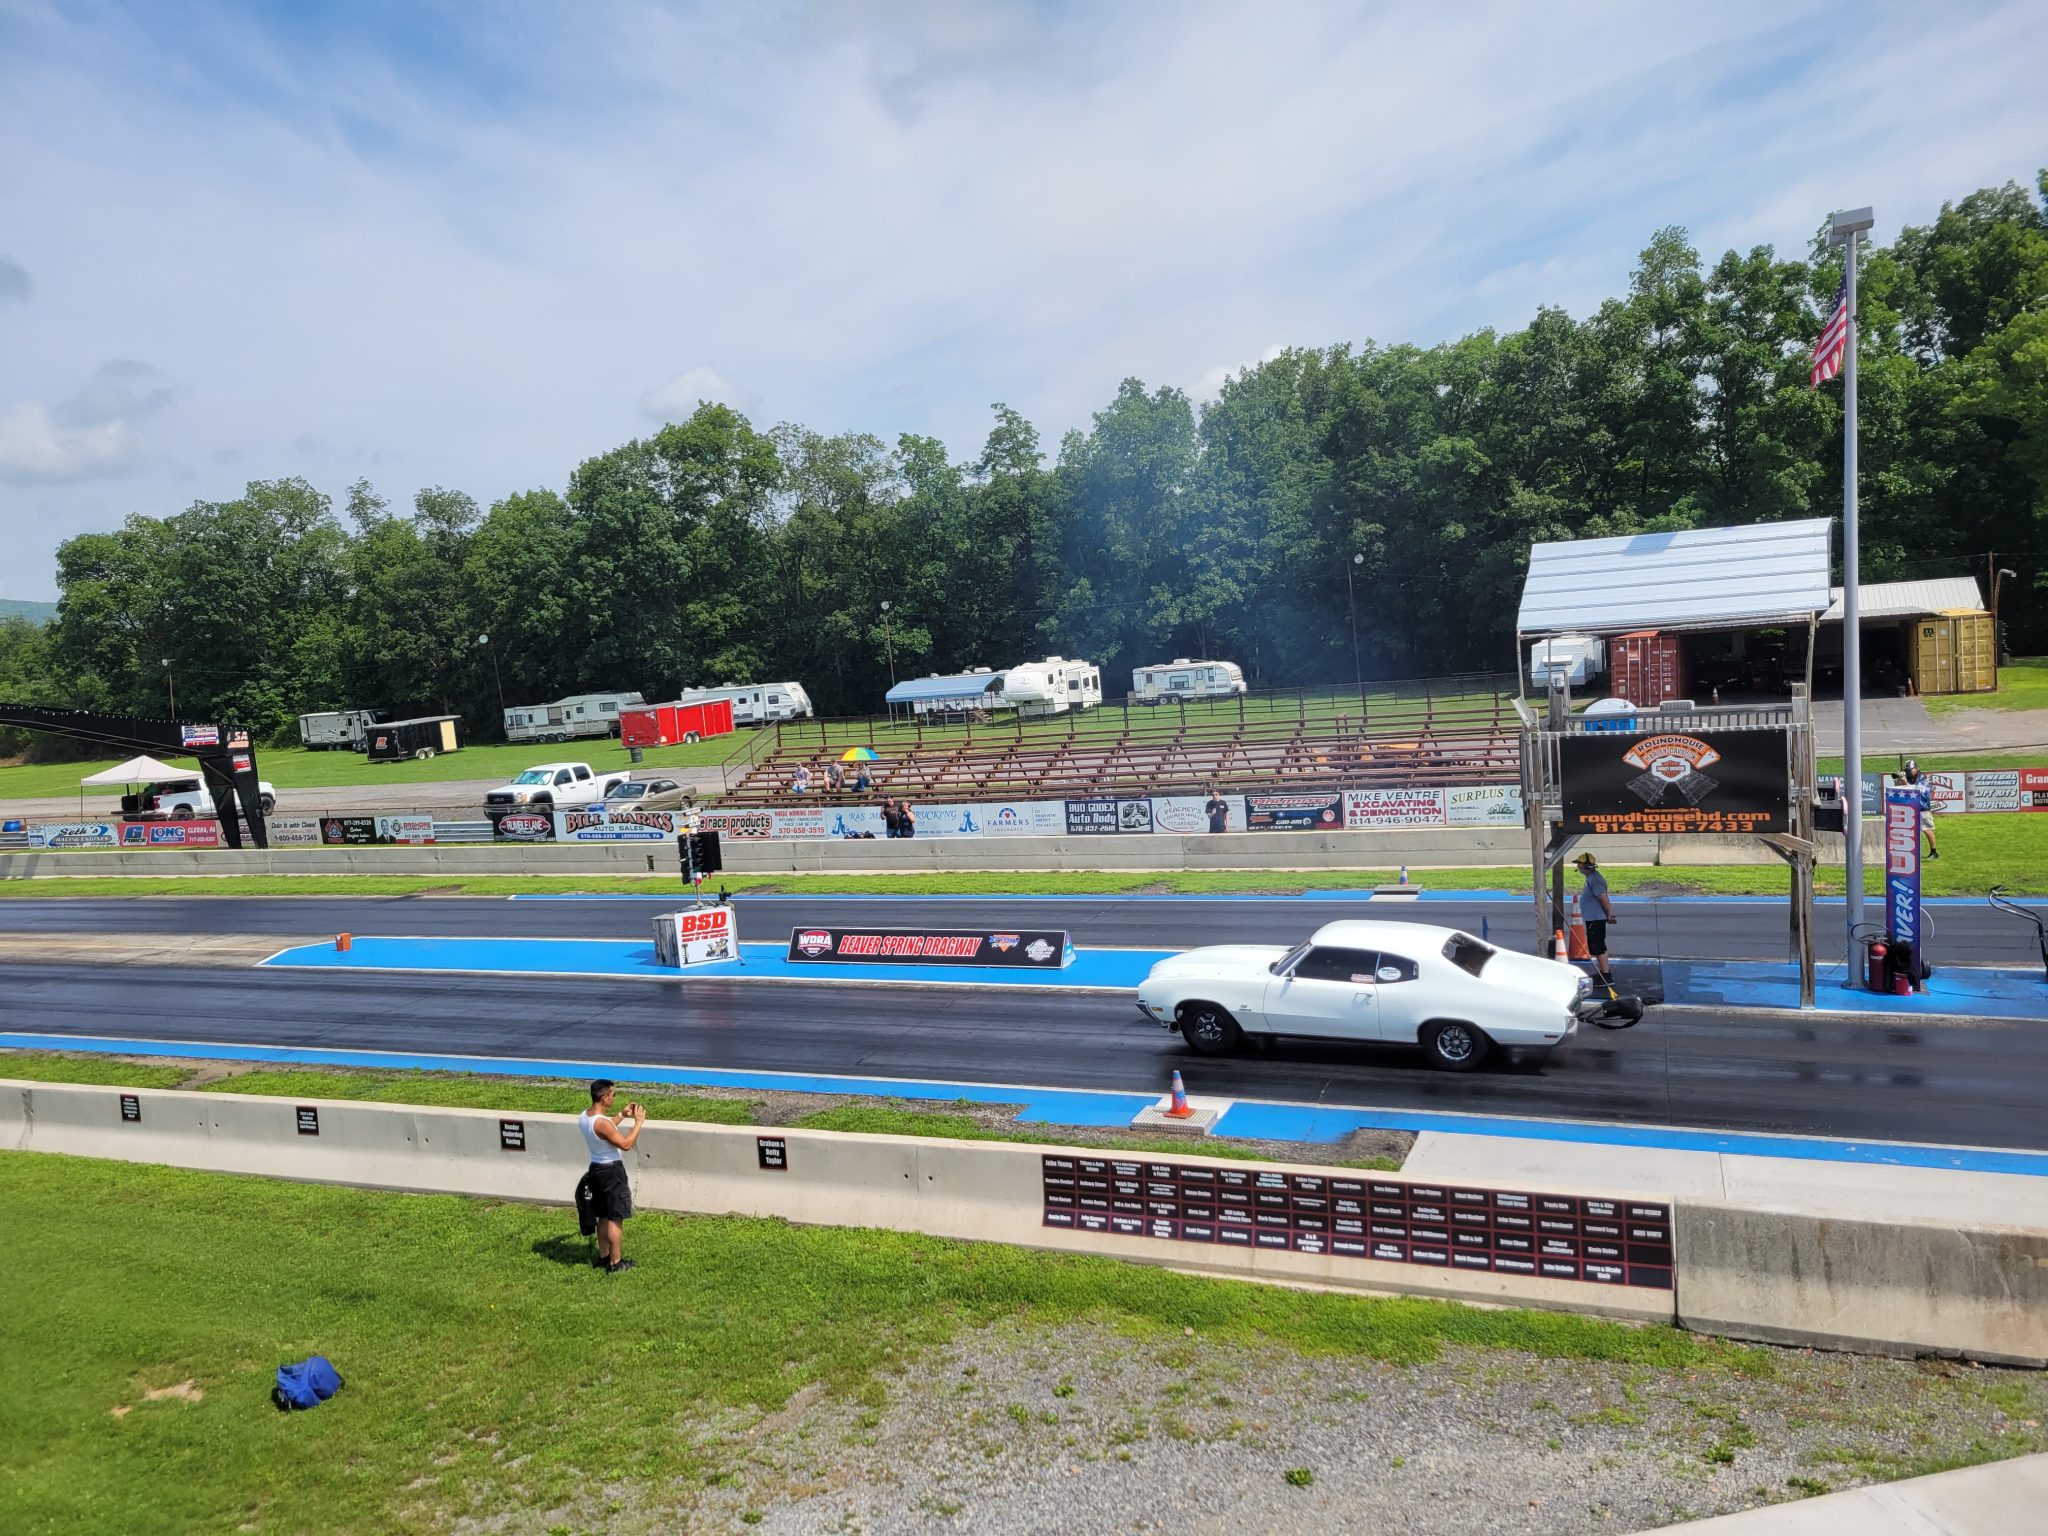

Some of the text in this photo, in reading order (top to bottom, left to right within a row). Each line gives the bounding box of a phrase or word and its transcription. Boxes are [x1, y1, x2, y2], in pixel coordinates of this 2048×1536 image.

[1637, 737, 1704, 752] ROUNDHOUSE
[1348, 791, 1440, 801] MIKE VENTRE
[1451, 788, 1504, 804] SURPLUS
[1974, 788, 2018, 798] LIFT KITS
[1068, 803, 1086, 812] BUD
[1353, 799, 1436, 808] EXCAVATING
[1975, 801, 2018, 809] INSPECTIONS
[915, 809, 957, 821] RUCKING
[1068, 813, 1090, 823] Auto
[1092, 812, 1117, 824] Body
[1349, 807, 1442, 817] & DEMOLITION
[1579, 811, 1771, 823] roundhousehd.com
[565, 812, 673, 833] BILL MARKS
[708, 818, 728, 828] race
[730, 813, 770, 836] products
[1350, 815, 1439, 824] 814-946-9047
[60, 825, 99, 836] Seth's
[1595, 821, 1753, 833] 814-696-7433
[150, 826, 185, 843] LONG
[1889, 804, 1915, 874] BSD
[1892, 880, 1914, 943] VER!
[681, 911, 727, 933] BSD
[799, 935, 831, 945] WDRA
[837, 935, 882, 955] BEAVER
[880, 936, 924, 955] SPRING
[922, 936, 983, 957] DRAGWAY
